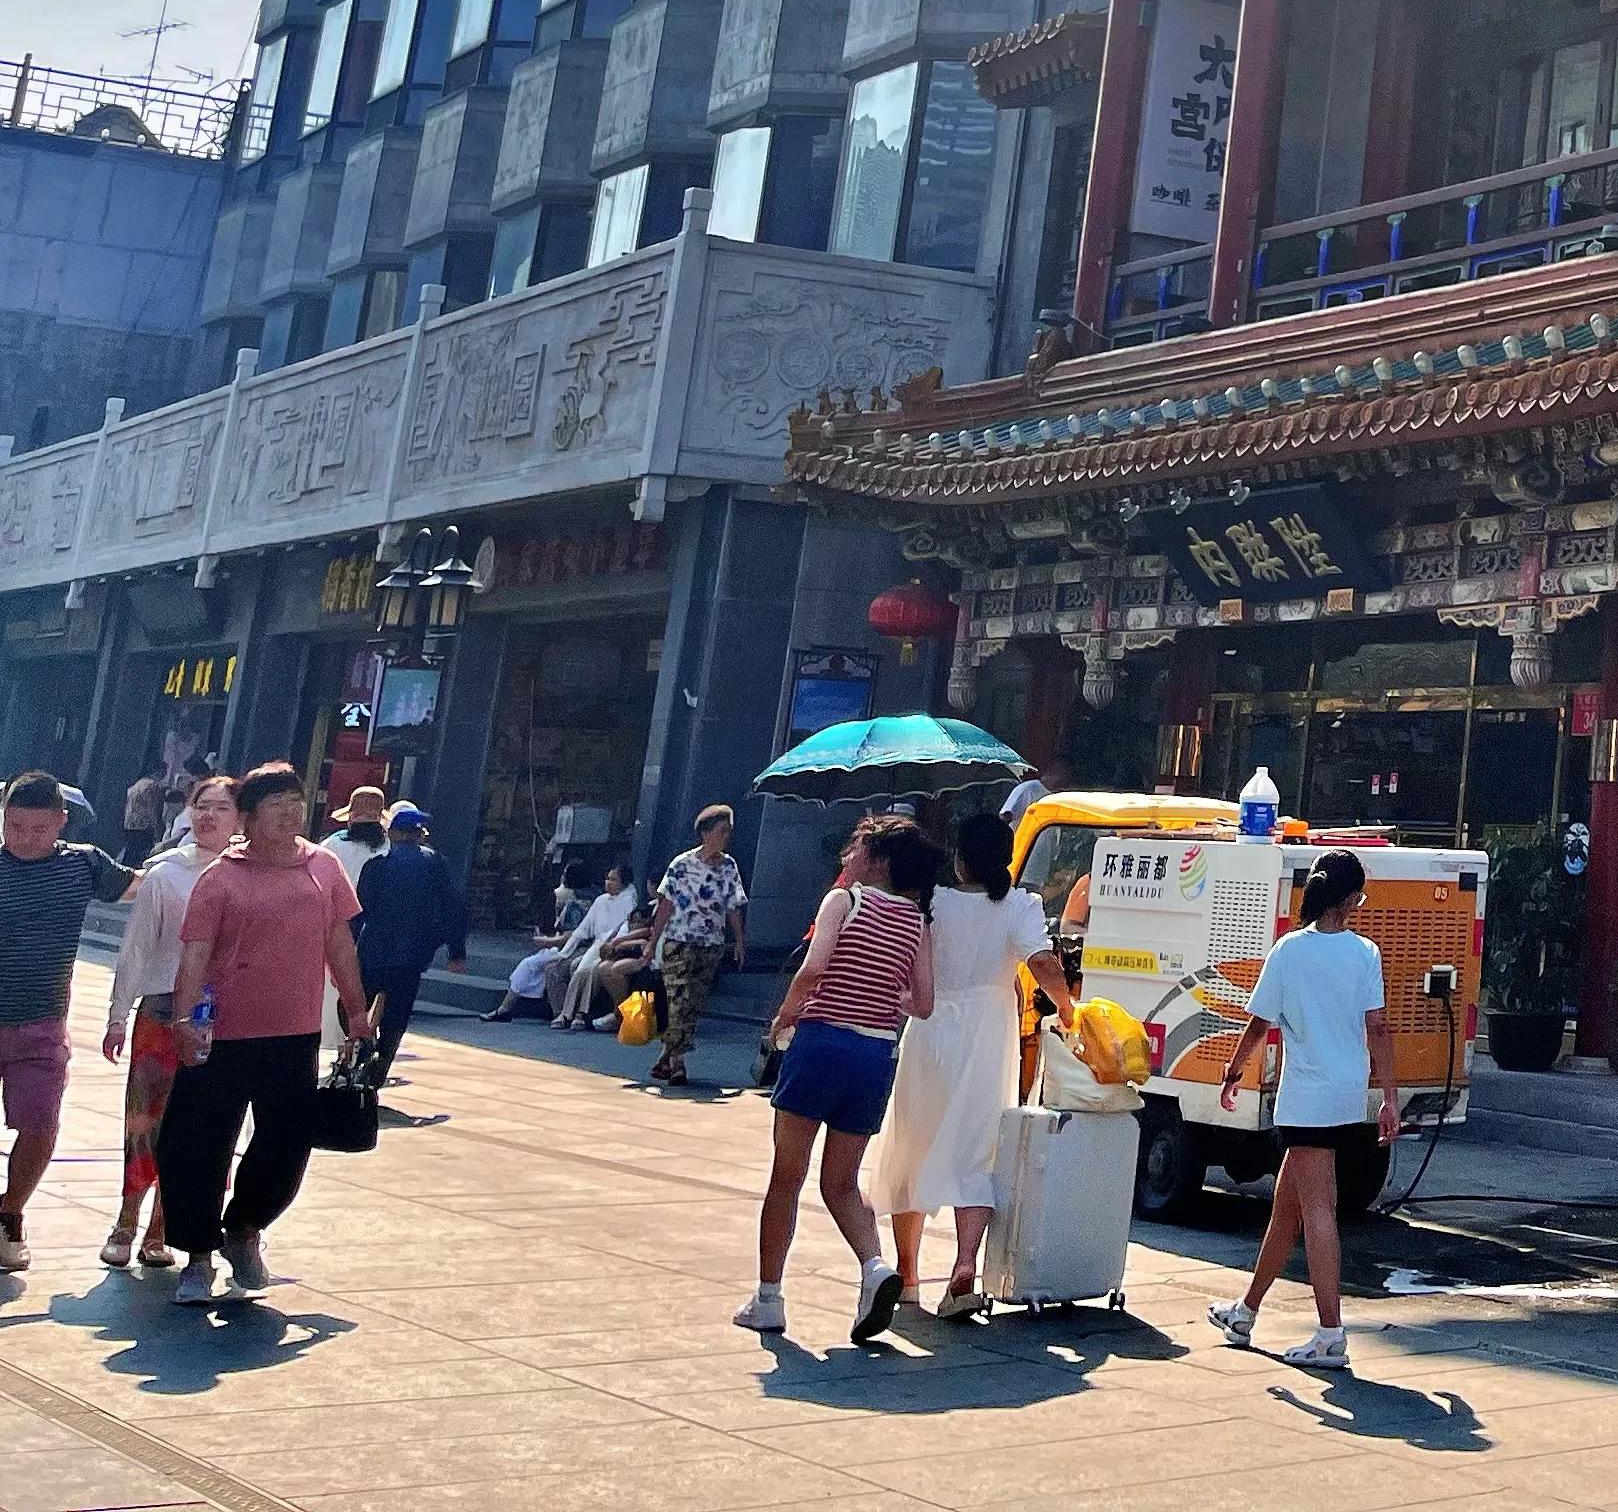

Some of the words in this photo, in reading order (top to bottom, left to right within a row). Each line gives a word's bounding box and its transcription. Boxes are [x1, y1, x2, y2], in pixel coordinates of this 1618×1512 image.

[1151, 183, 1191, 205] 咖啡
[1103, 853, 1169, 880] 环雅丽都
[1099, 884, 1164, 899] HUANYALIDU
